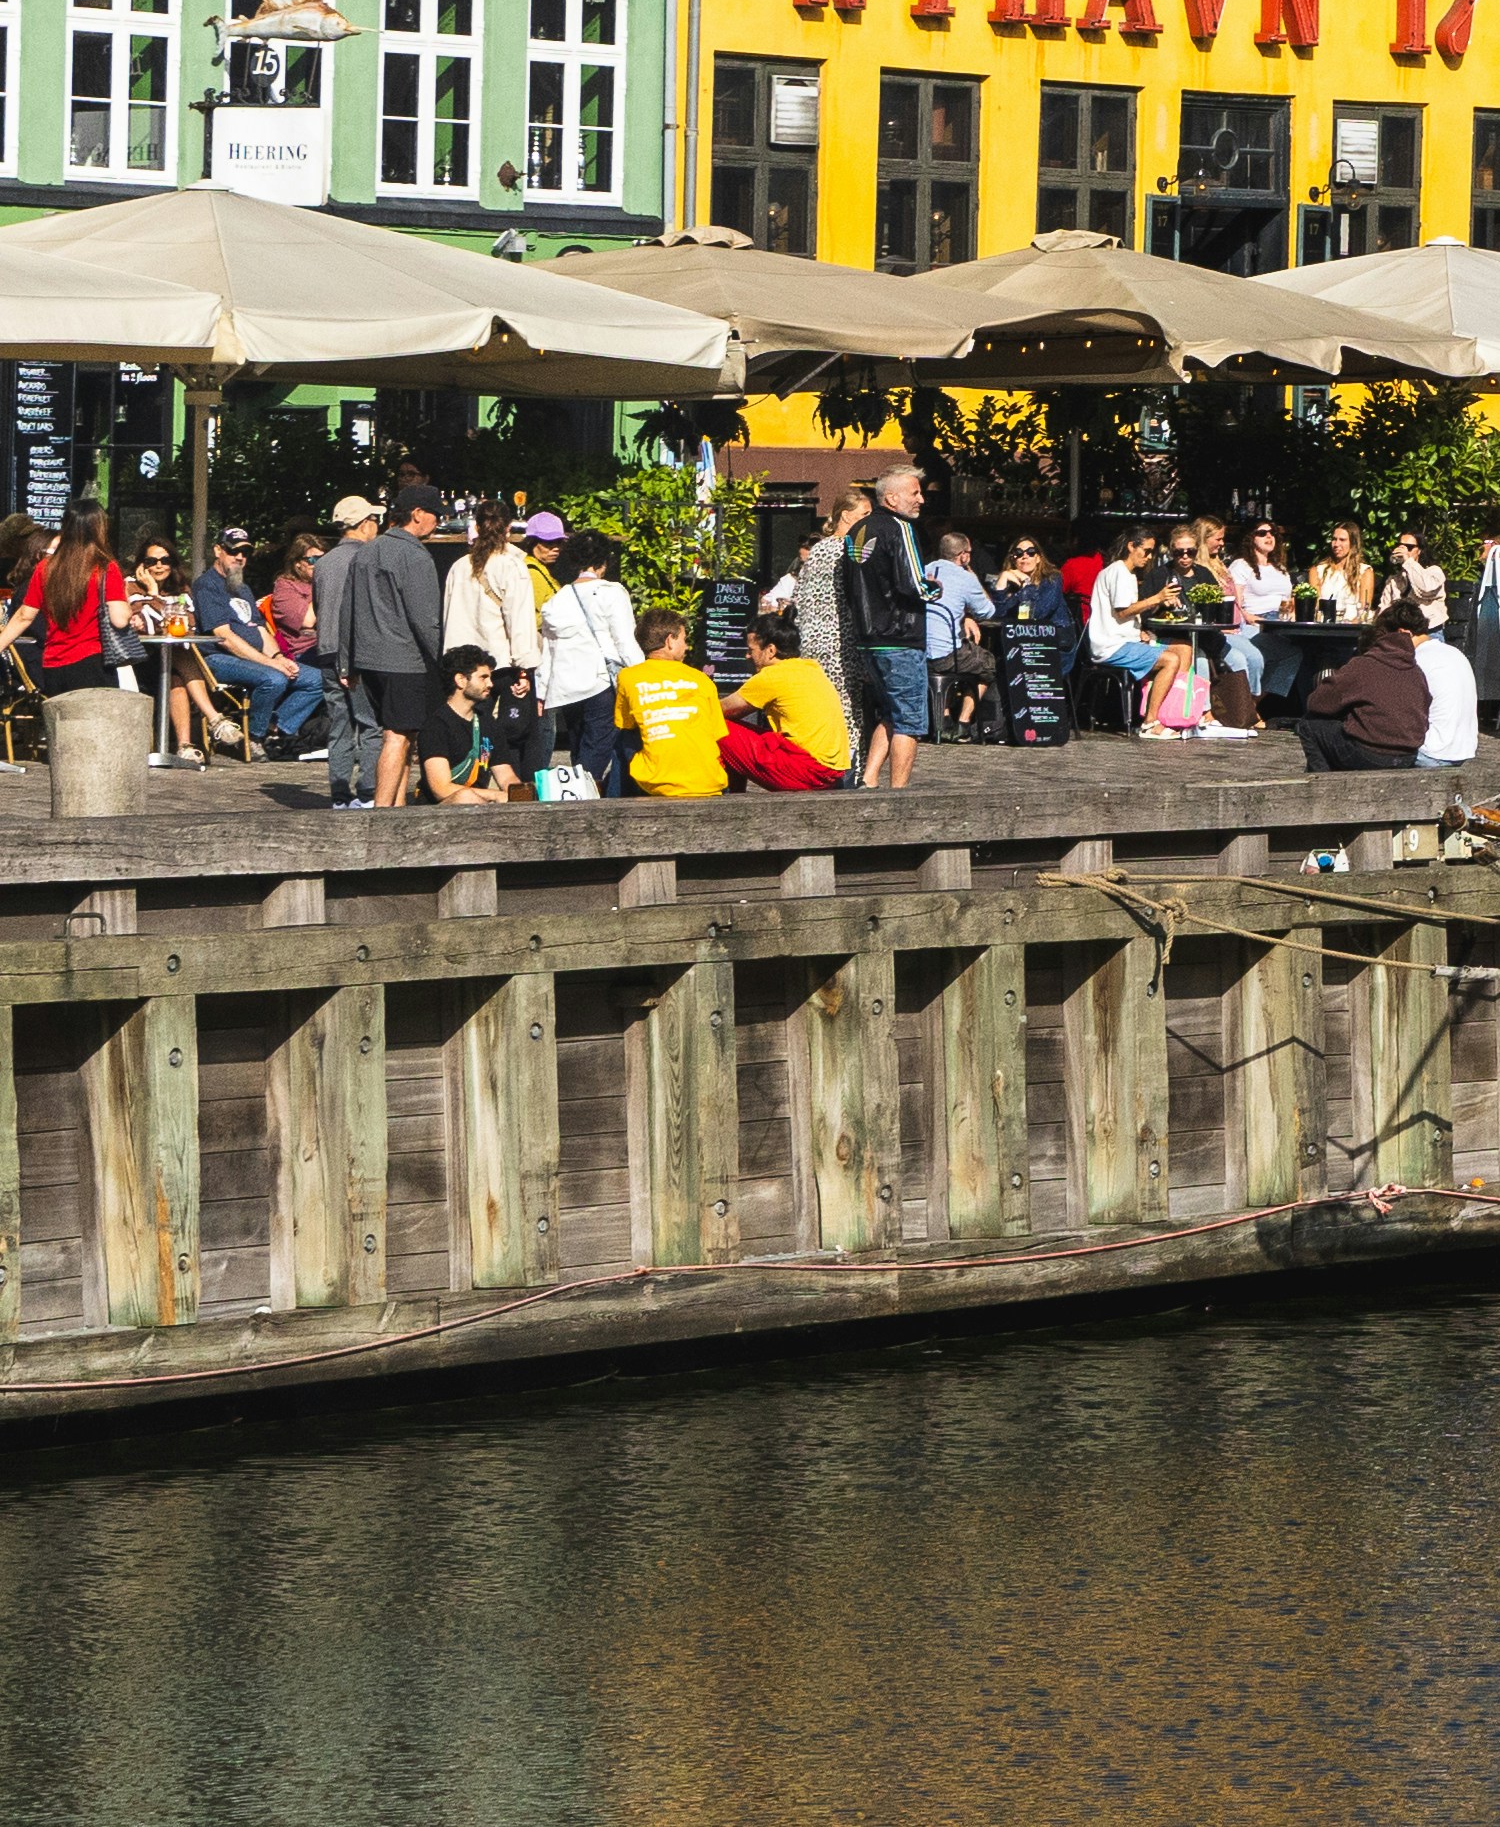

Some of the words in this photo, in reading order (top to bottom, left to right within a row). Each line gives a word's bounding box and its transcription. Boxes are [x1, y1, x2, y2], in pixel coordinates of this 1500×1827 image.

[253, 50, 277, 75] 15
[229, 143, 308, 161] HEERING
[1158, 215, 1168, 227] 17
[1309, 223, 1320, 235] 17
[716, 583, 745, 594] DANISH
[714, 594, 751, 605] CLASSICS
[1006, 624, 1015, 639] 3
[1409, 829, 1419, 852] 9
